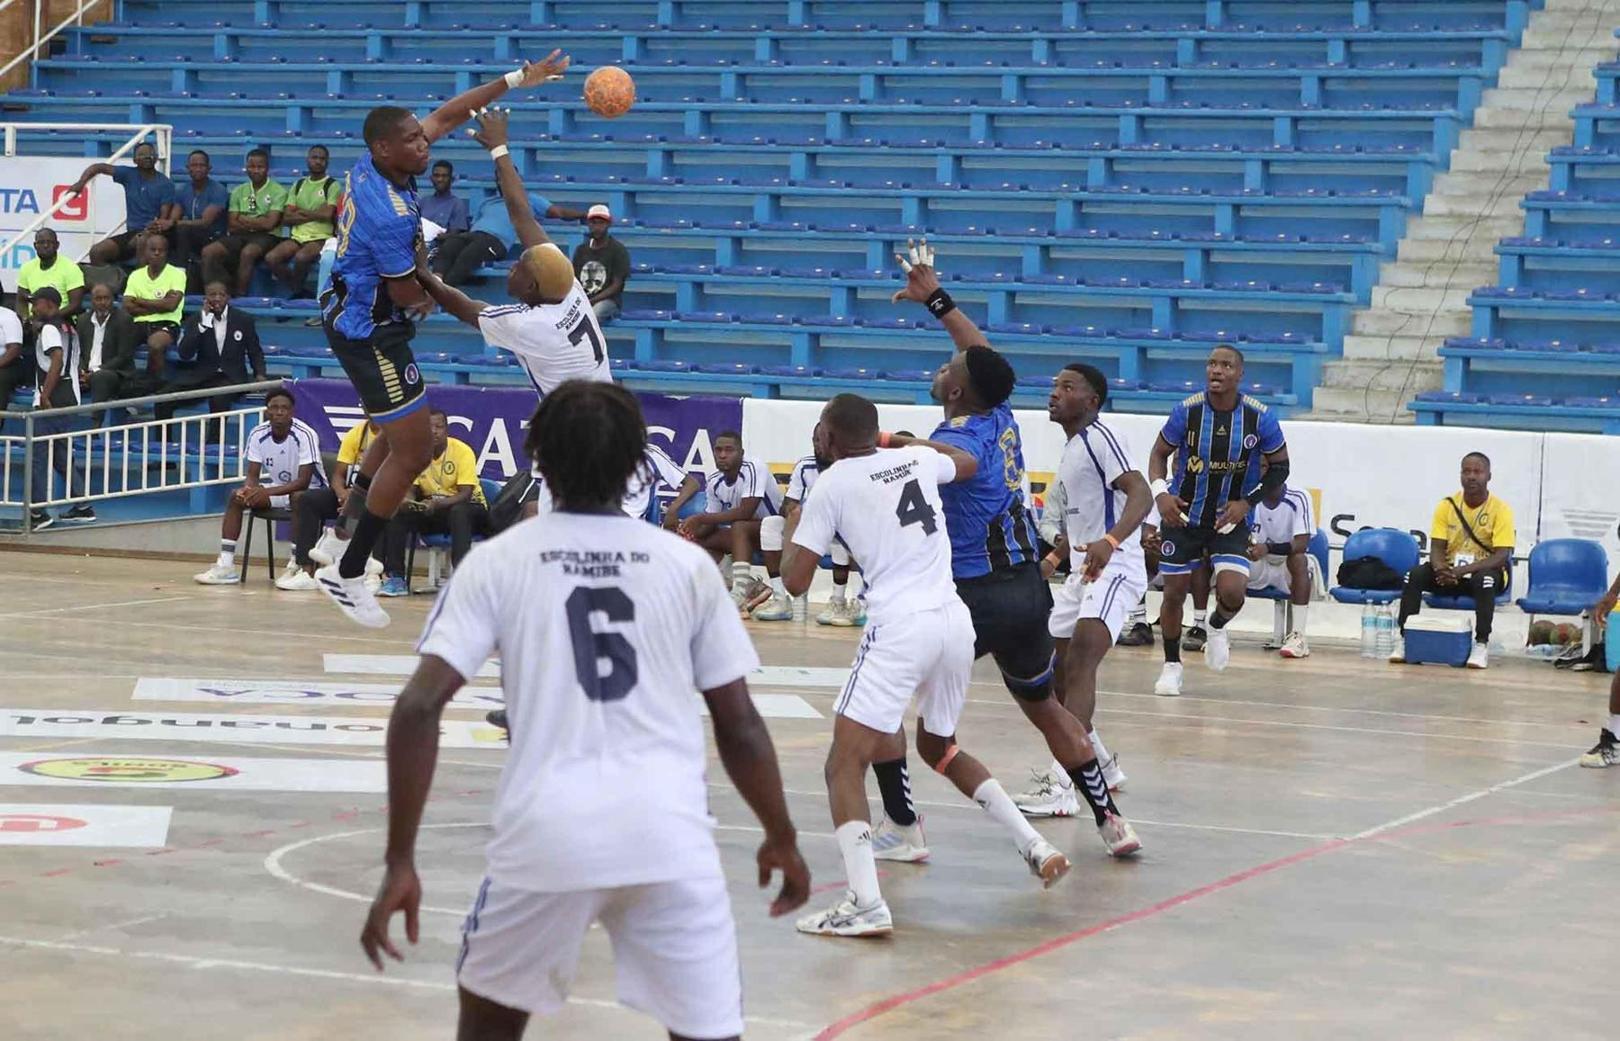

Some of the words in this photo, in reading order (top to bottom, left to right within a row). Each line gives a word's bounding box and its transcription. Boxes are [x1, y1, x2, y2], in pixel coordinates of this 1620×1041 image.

[567, 313, 604, 367] 7
[895, 478, 938, 536] 4
[630, 551, 650, 563] DO
[565, 586, 638, 702] 6
[10, 714, 386, 733] onangol
